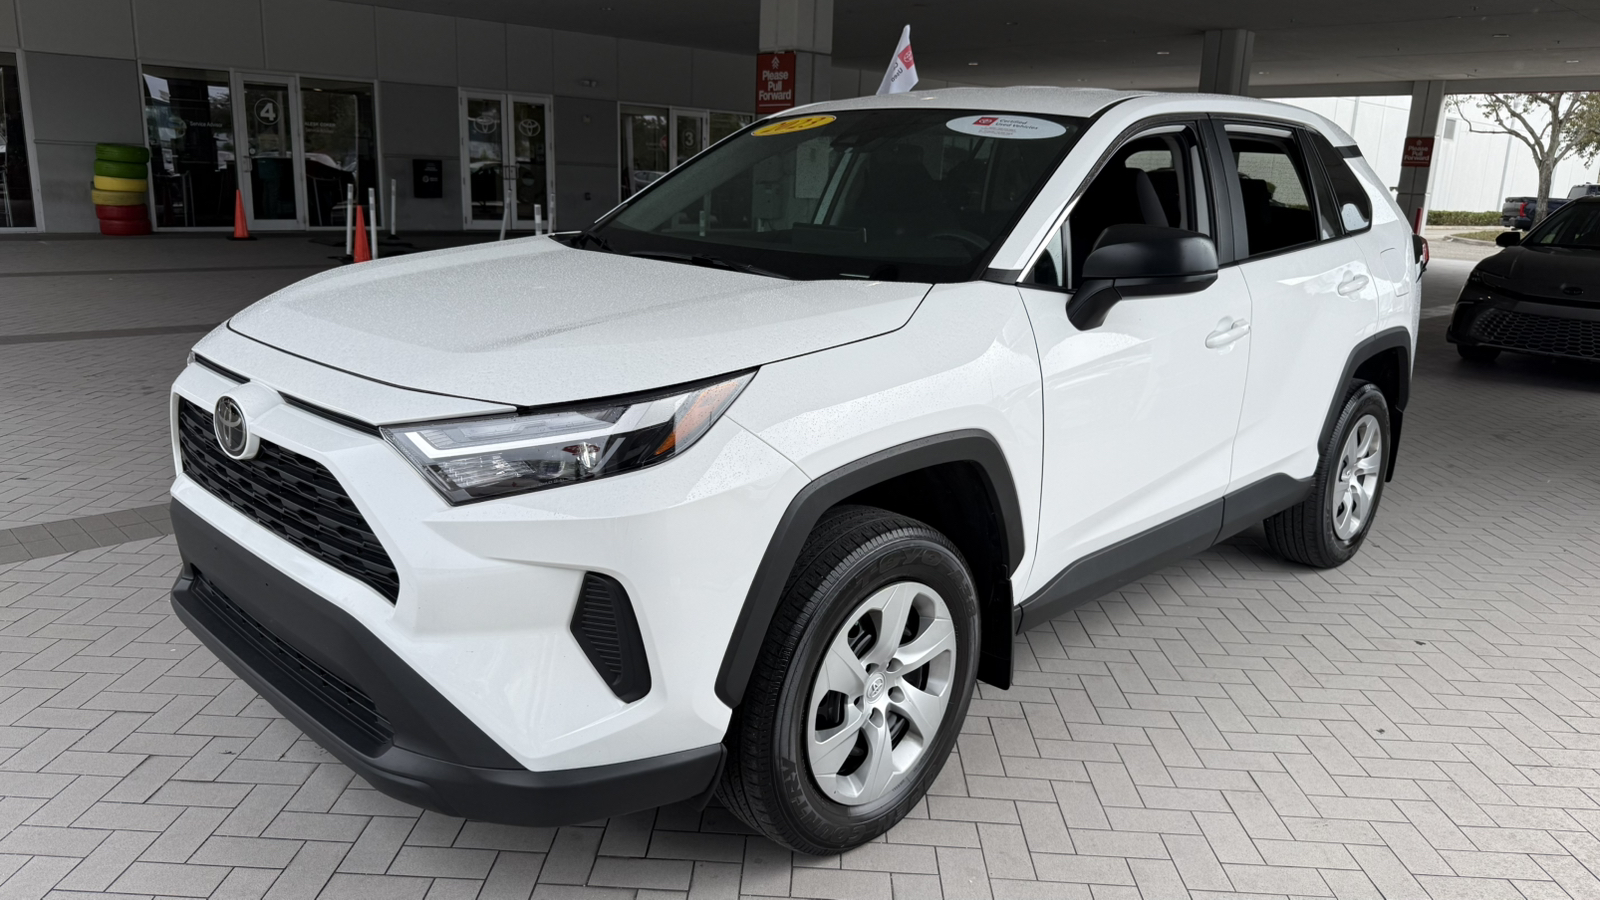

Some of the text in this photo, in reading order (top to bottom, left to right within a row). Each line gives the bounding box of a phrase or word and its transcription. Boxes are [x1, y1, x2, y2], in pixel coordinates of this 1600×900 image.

[762, 70, 789, 81] Please
[767, 81, 783, 92] Pull
[758, 89, 792, 101] Forward
[260, 102, 276, 121] 4
[685, 131, 694, 146] 3
[780, 756, 867, 844] COUNTRY
